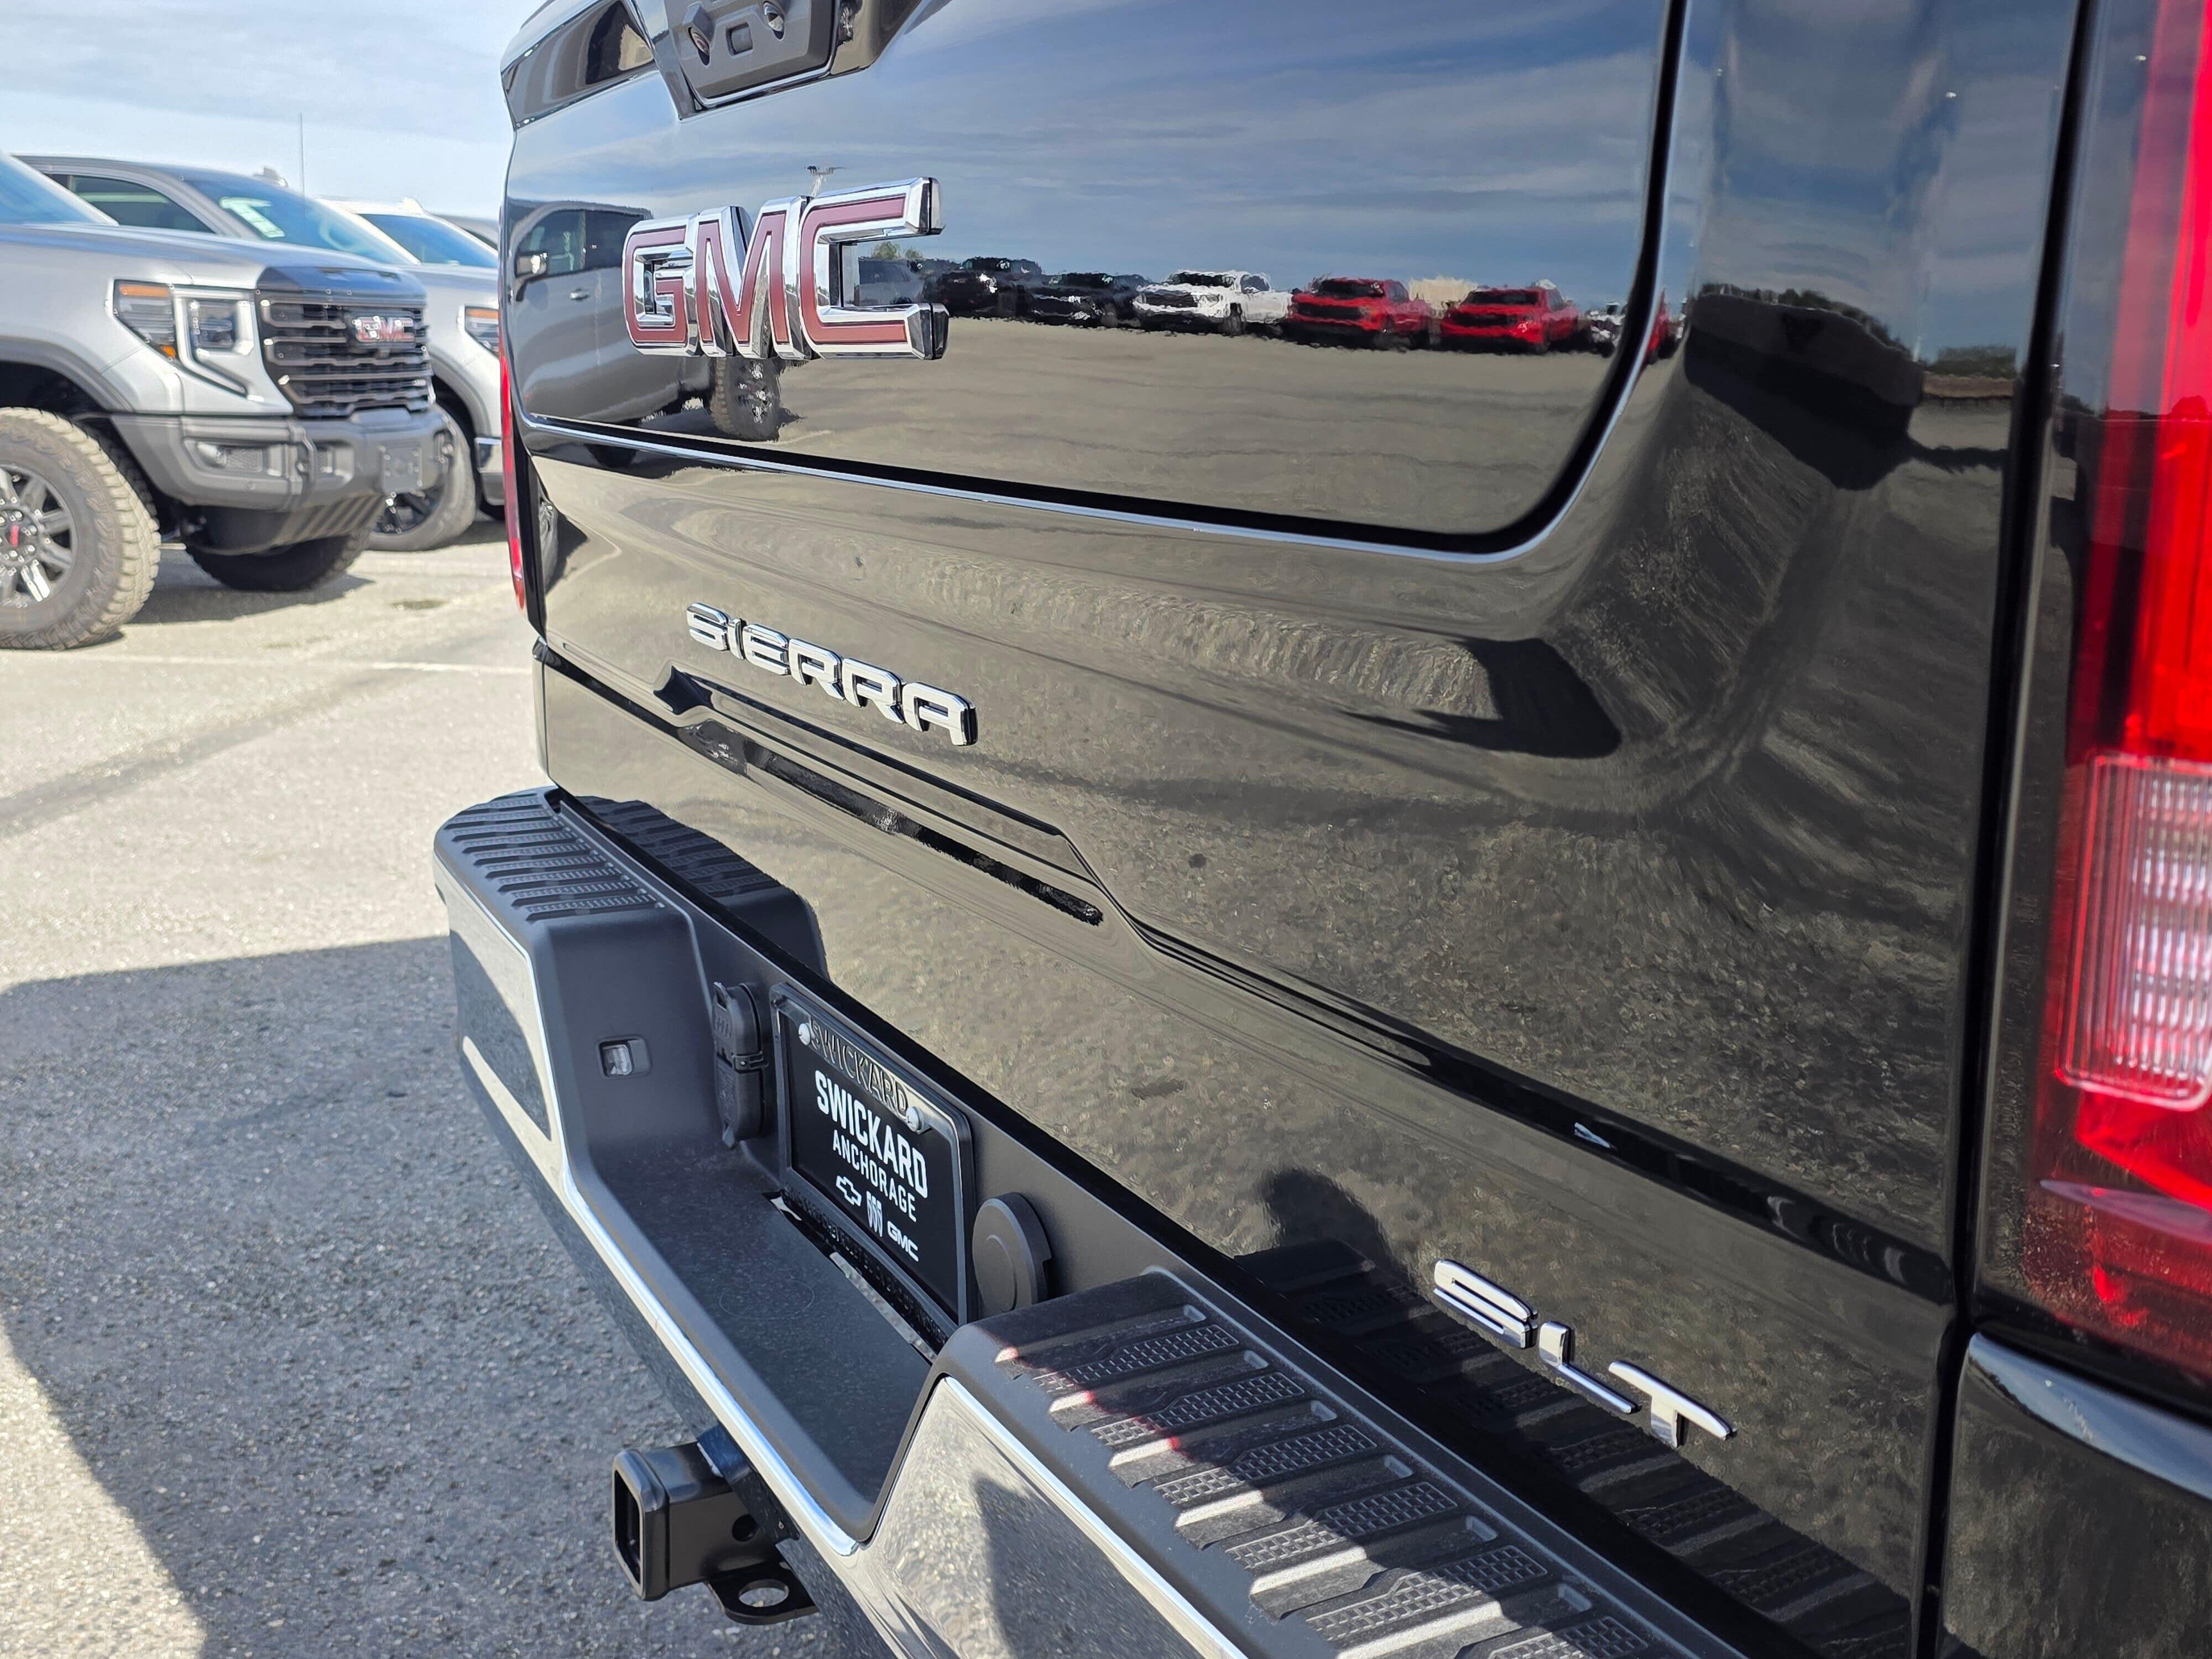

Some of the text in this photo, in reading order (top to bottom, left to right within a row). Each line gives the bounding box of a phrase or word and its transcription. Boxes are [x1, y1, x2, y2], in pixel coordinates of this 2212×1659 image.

[622, 176, 950, 361] GMC
[686, 602, 979, 746] SIERRA
[810, 1019, 910, 1121] SWICKARD
[815, 1070, 928, 1199] SWICKARD
[832, 1130, 917, 1223] ANCHORAGE
[887, 1220, 919, 1262] GMC
[1433, 1258, 1737, 1449] SLT
